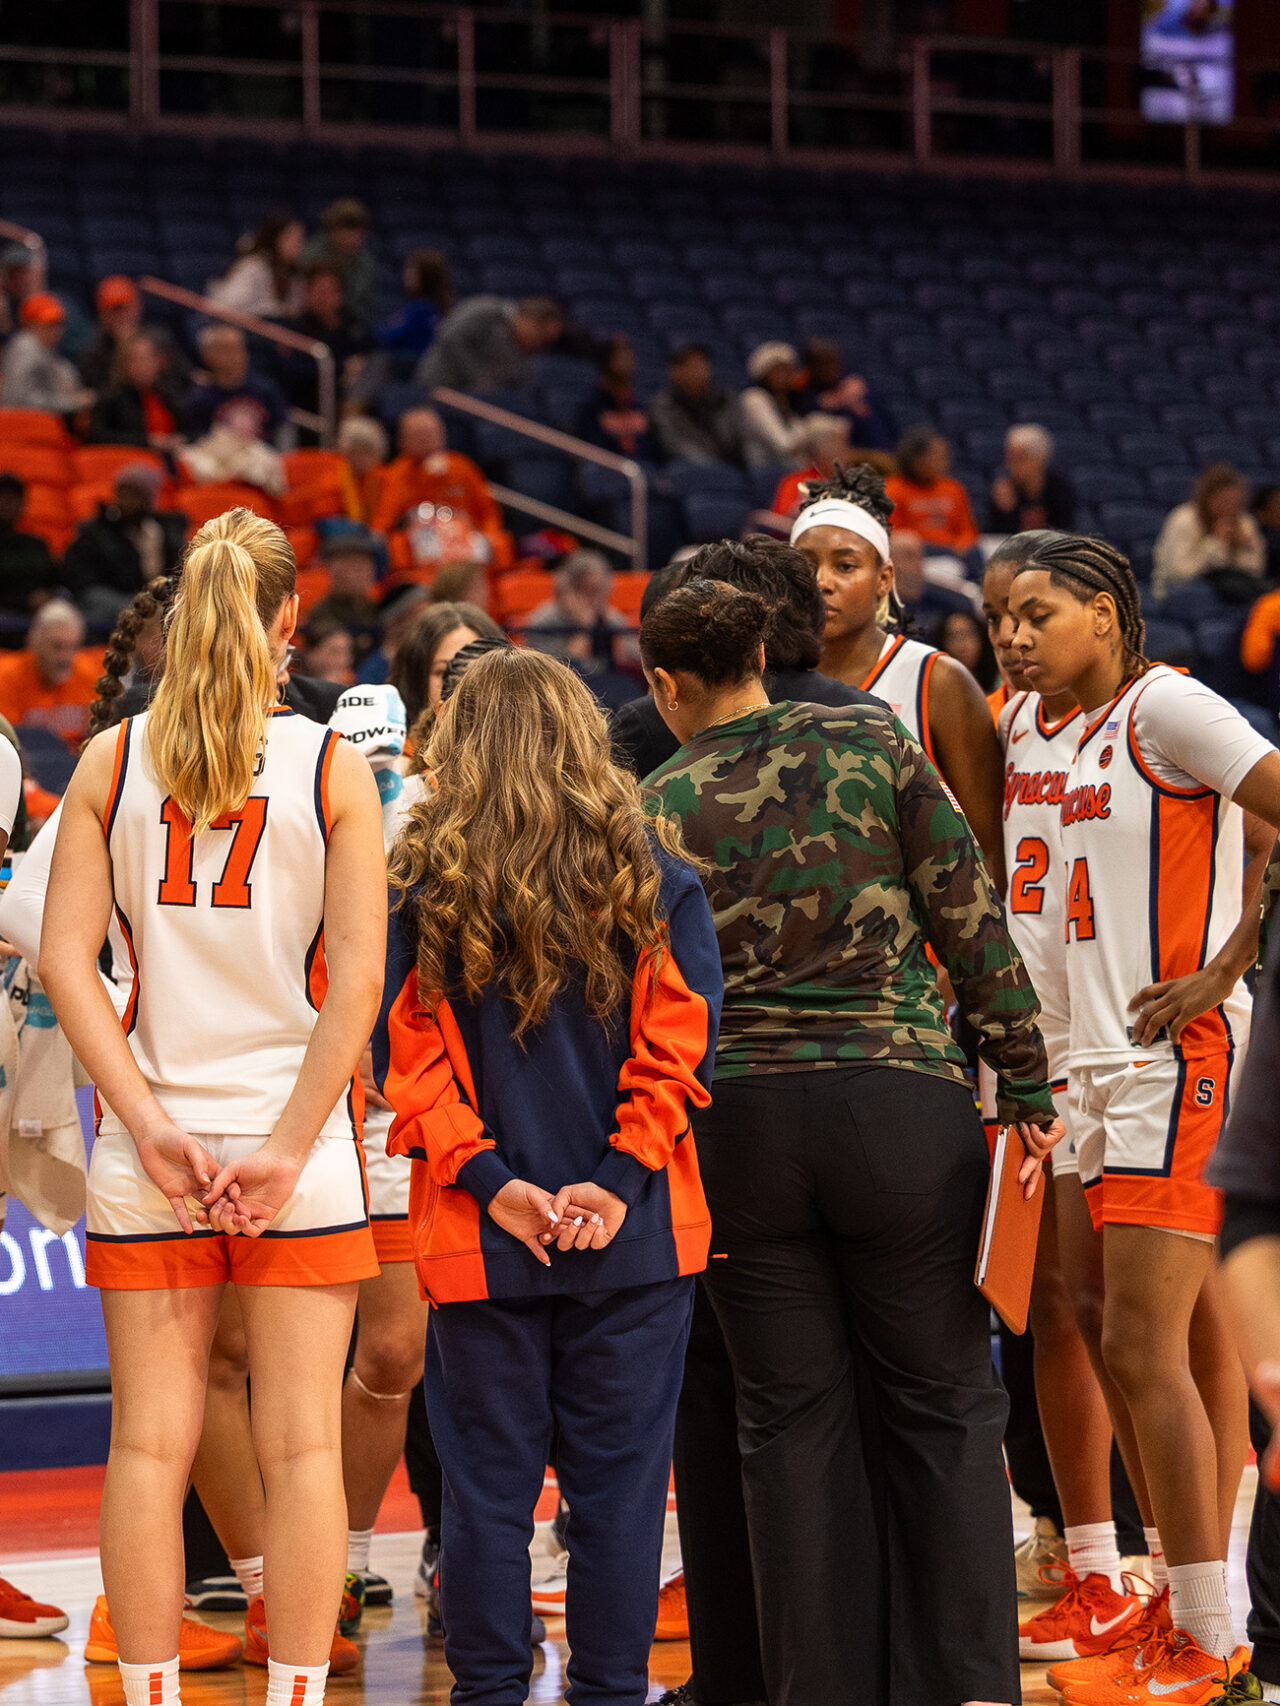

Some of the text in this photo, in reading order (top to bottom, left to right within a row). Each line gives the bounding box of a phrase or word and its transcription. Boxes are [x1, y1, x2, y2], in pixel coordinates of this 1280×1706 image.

[157, 794, 270, 909] 17
[1010, 837, 1050, 914] 2
[1195, 1076, 1215, 1106] S
